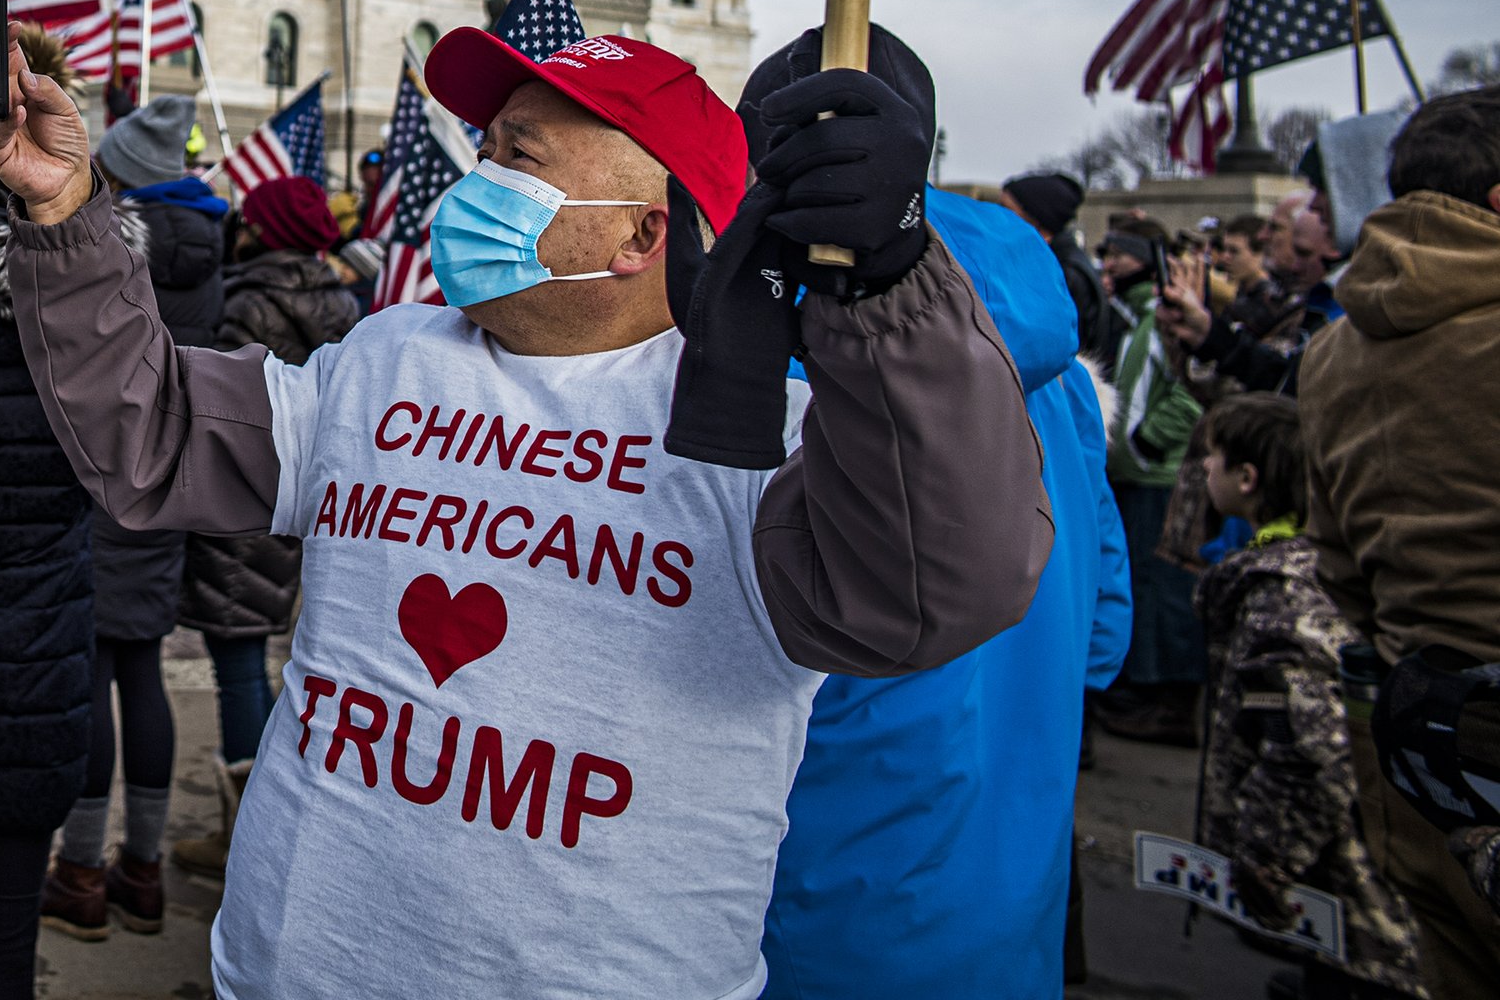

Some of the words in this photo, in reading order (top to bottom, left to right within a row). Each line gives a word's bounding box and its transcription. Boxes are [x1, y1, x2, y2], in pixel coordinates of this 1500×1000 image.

[374, 401, 653, 495] CHINESE
[314, 480, 695, 608] AMERICANS
[299, 674, 633, 849] TRUMP
